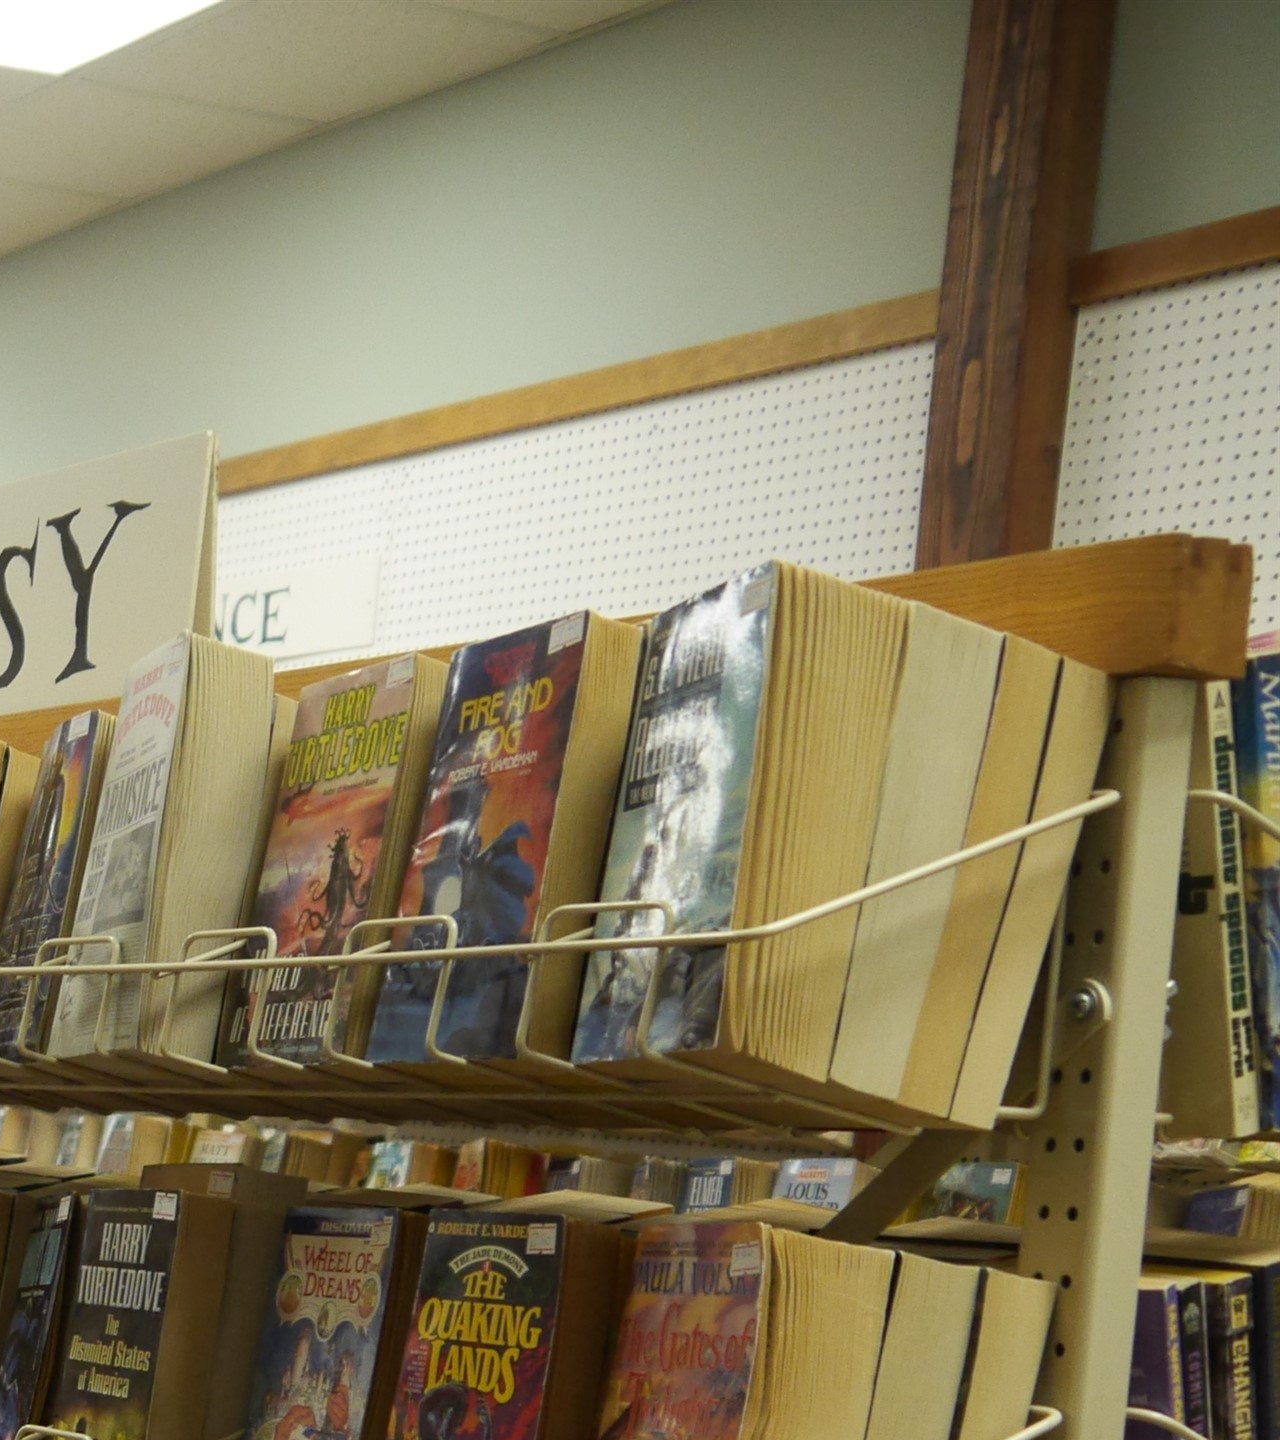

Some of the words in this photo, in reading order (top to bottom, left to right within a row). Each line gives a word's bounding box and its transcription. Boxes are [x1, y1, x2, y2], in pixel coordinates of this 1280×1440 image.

[322, 684, 376, 732] HARRY
[458, 697, 503, 735] FIRE
[505, 676, 554, 719] AND
[473, 721, 524, 761] FOG
[448, 761, 481, 783] ROBERT
[489, 750, 538, 775] VARDEMAN
[95, 757, 166, 838] ARMISTICE
[98, 1221, 153, 1265] HARRY
[436, 1221, 481, 1238] ROBERT
[303, 1243, 353, 1275] WHEEL
[354, 1251, 375, 1275] OF
[453, 1255, 473, 1271] THE
[470, 1247, 492, 1261] JADE
[491, 1248, 527, 1274] DEMONS
[77, 1264, 166, 1313] TURTLEDOVE
[303, 1271, 363, 1304] DREAMS
[461, 1271, 508, 1300] THE
[104, 1313, 120, 1335] The
[417, 1296, 542, 1349] QUAKING
[658, 1301, 722, 1374] Gates
[722, 1315, 758, 1371] of
[69, 1334, 114, 1367] Disunited
[113, 1344, 152, 1372] States
[423, 1338, 521, 1404] LANDS
[77, 1373, 88, 1391] of
[87, 1370, 130, 1399] America
